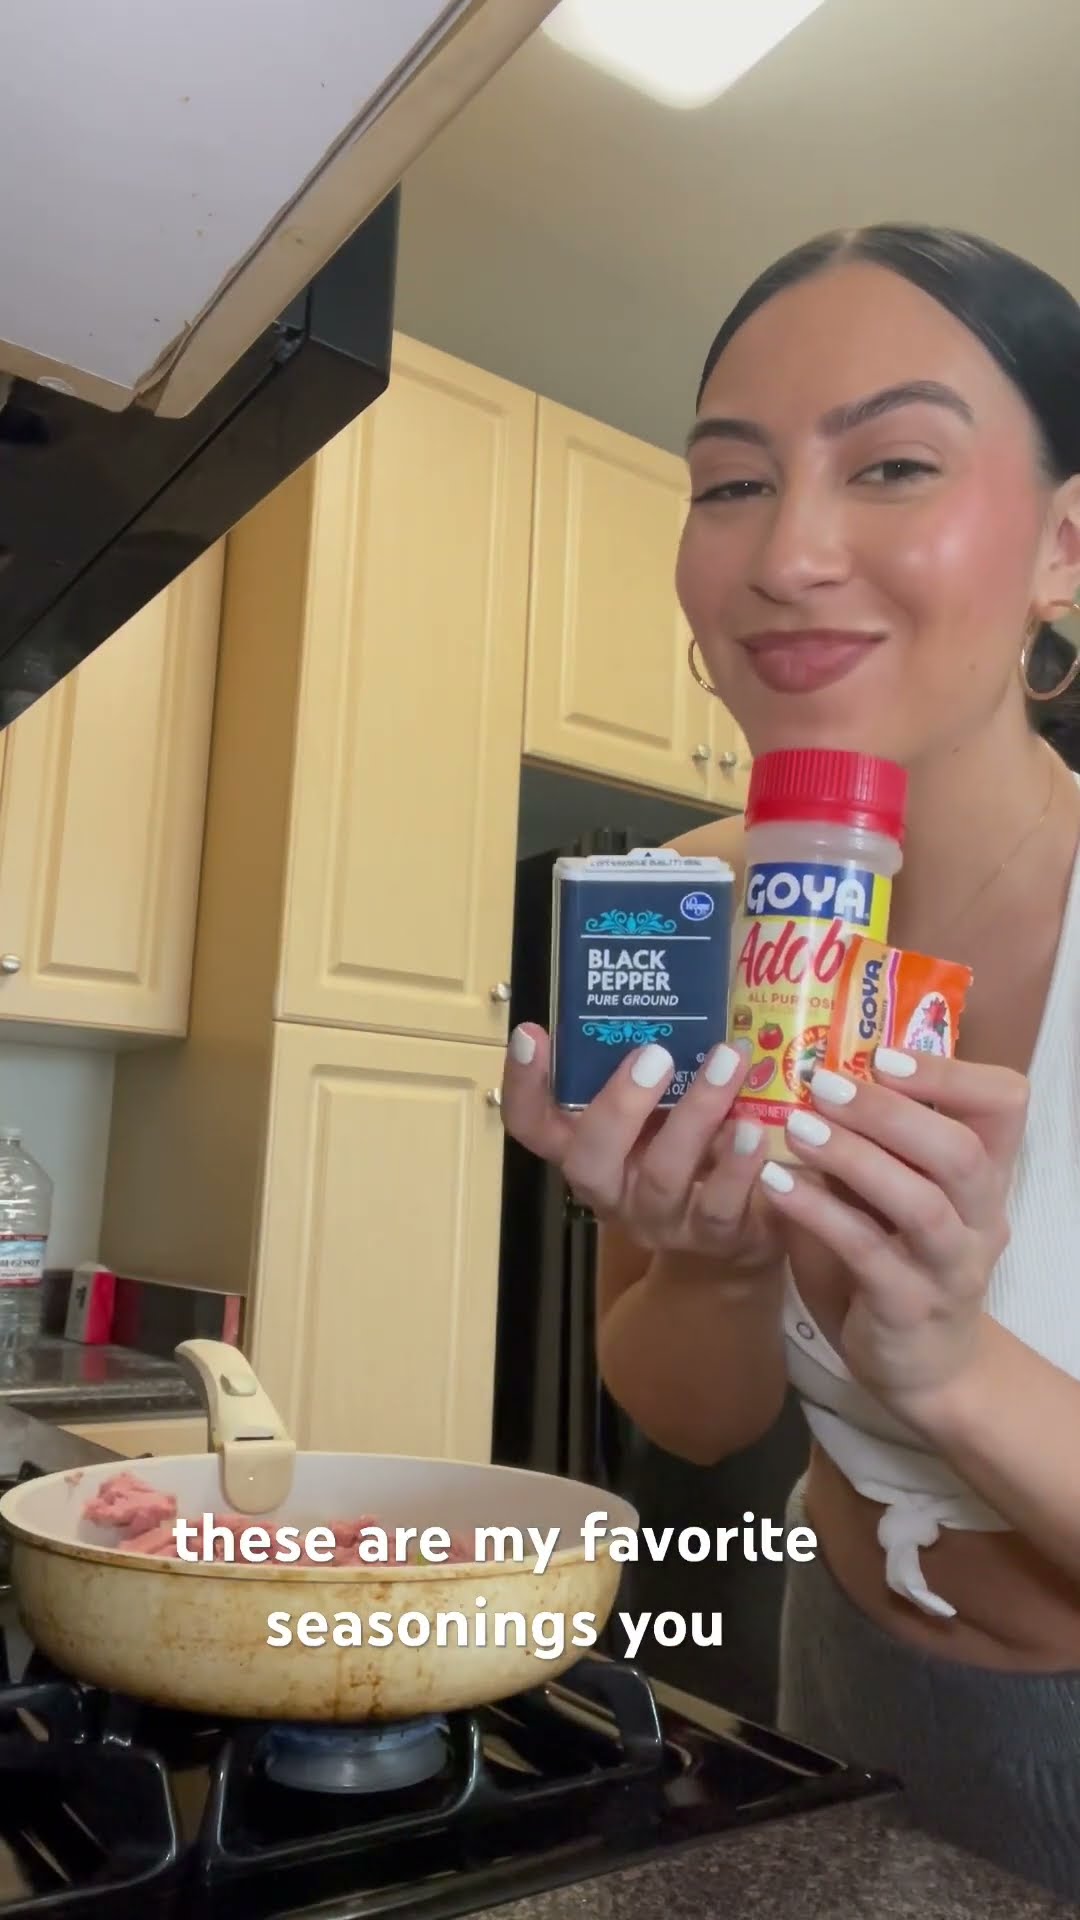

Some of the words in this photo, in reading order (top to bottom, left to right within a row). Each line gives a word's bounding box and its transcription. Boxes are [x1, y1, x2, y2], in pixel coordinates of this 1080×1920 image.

[746, 872, 867, 919] GOYA
[588, 949, 666, 970] BLACK
[737, 917, 846, 989] Adob
[587, 971, 671, 991] PEPPER
[586, 994, 619, 1006] PURE
[622, 995, 679, 1007] GROUND
[859, 959, 882, 1040] GOYA
